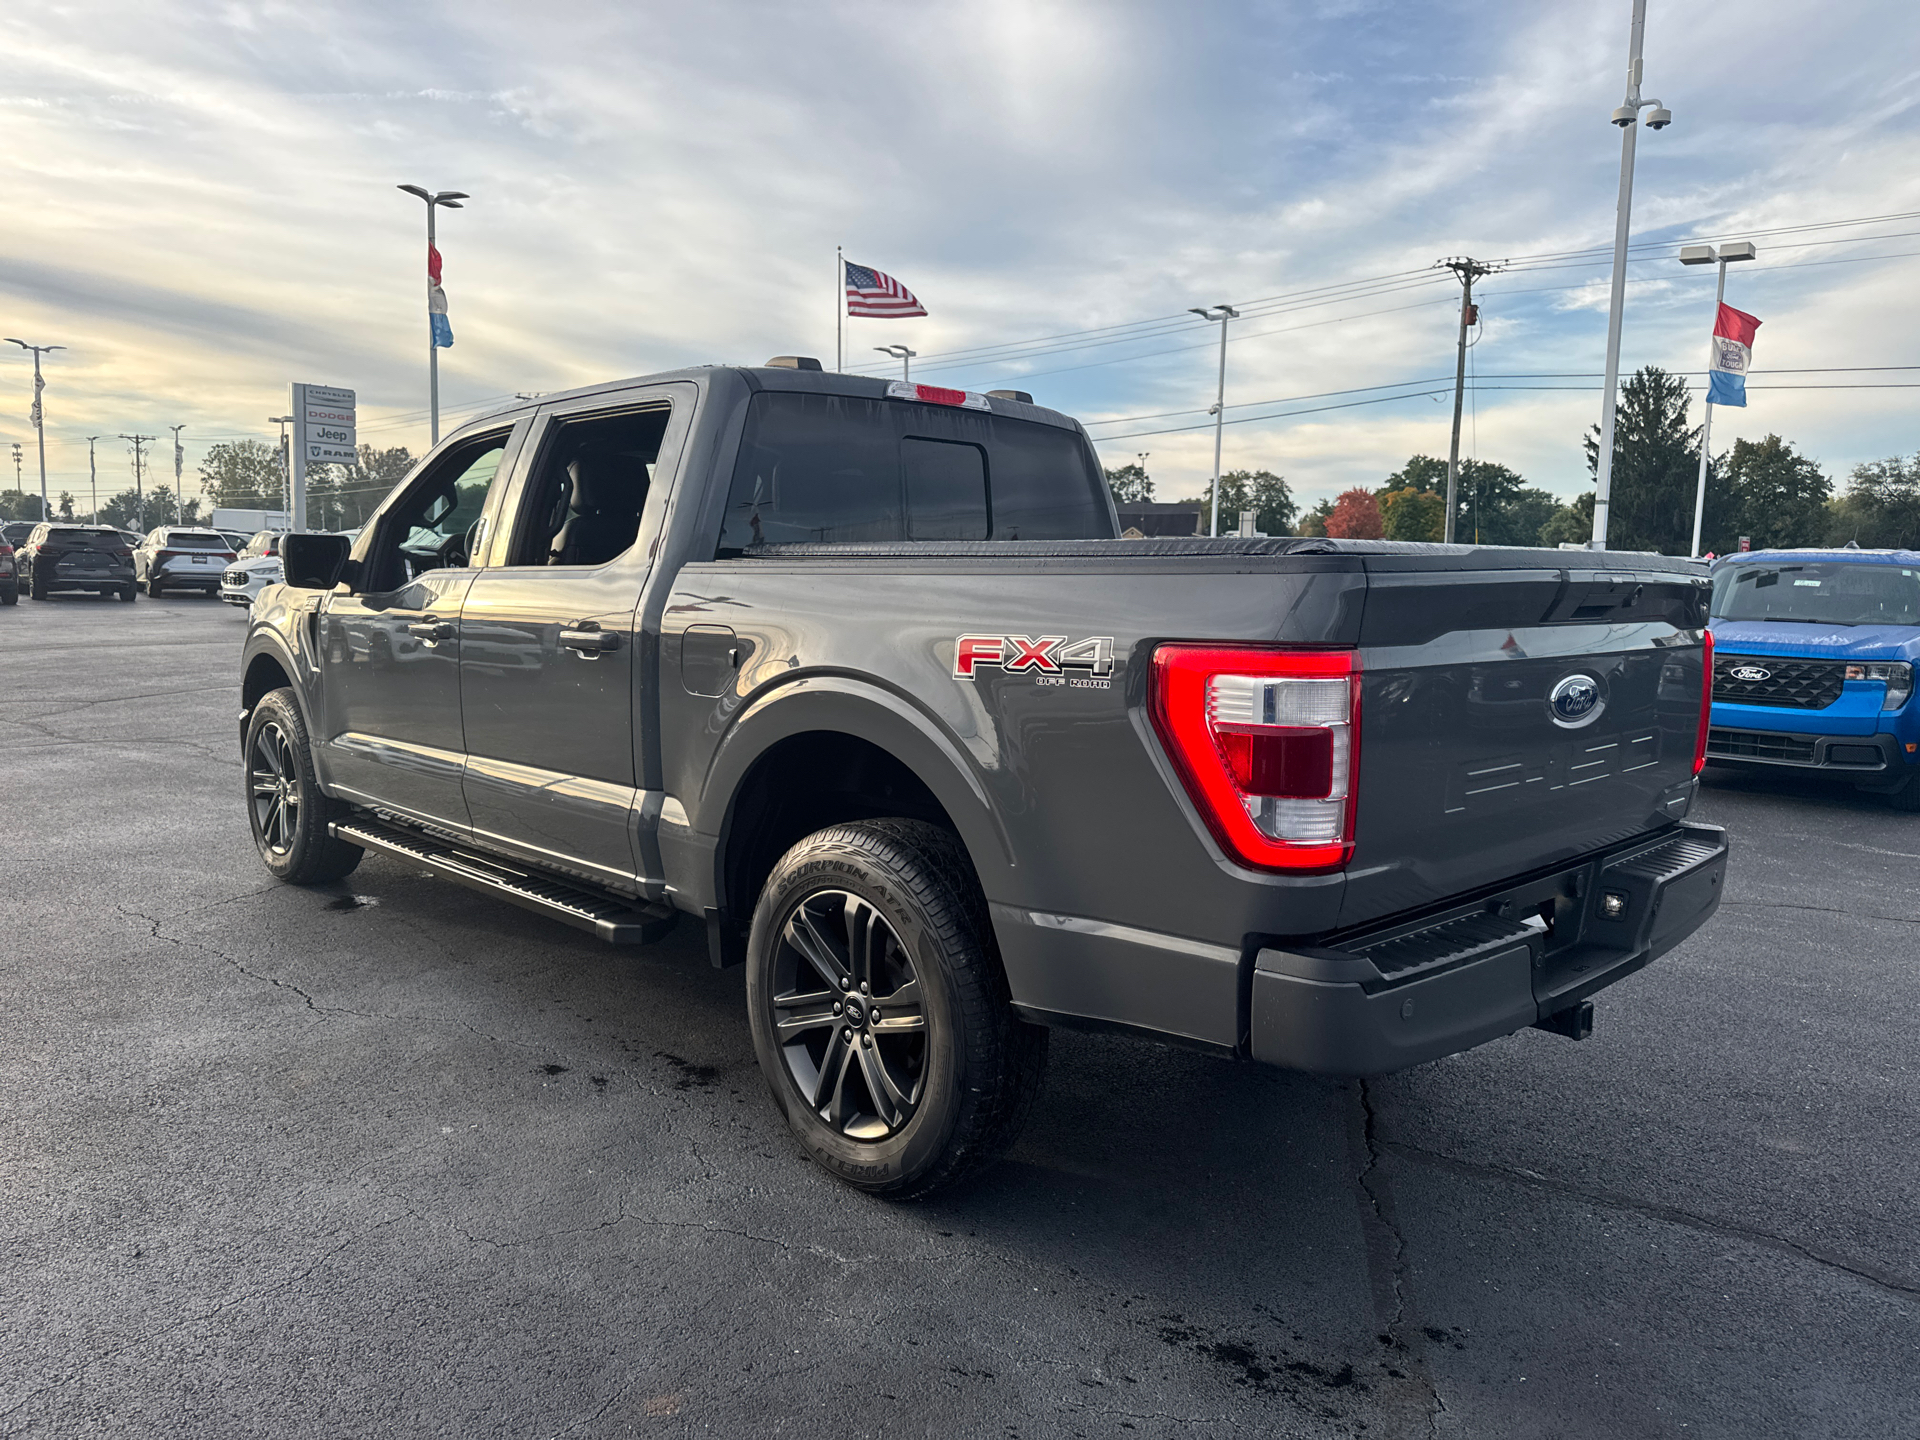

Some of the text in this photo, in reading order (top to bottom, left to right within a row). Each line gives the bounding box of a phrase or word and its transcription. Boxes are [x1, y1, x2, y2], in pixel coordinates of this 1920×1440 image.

[309, 389, 353, 399] CHRYSLER
[308, 411, 354, 421] DODGE
[316, 427, 348, 442] Jeep
[323, 449, 355, 458] RAM
[952, 633, 1115, 681] FX4
[1737, 668, 1764, 679] Ford
[1036, 677, 1111, 690] OFF ROAD
[1565, 685, 1592, 713] Ford
[777, 860, 869, 896] SCORPION
[871, 884, 912, 925] ATR
[815, 1146, 890, 1178] PIRELLI
